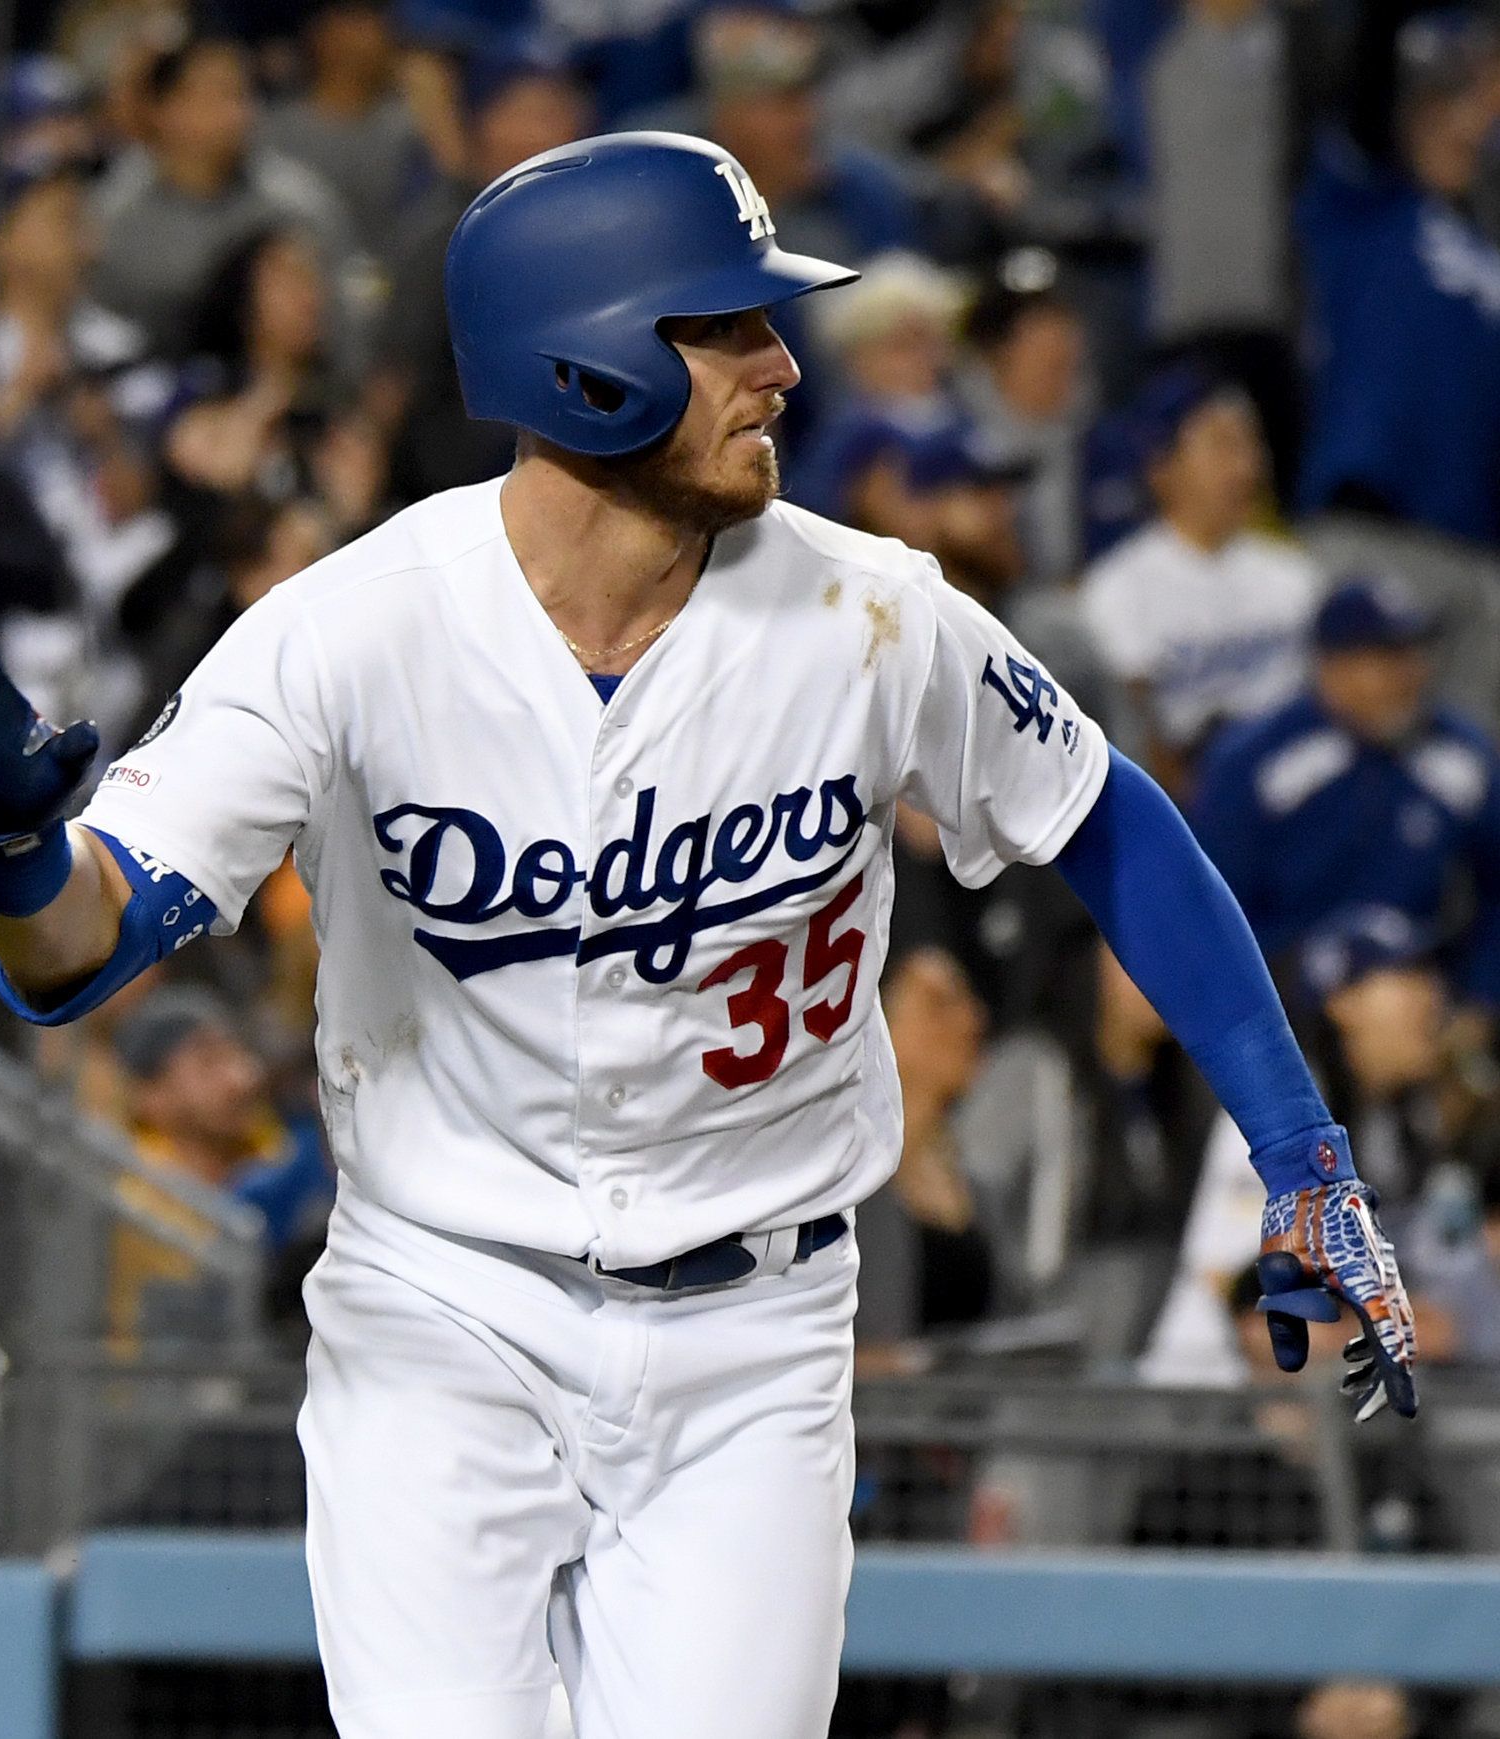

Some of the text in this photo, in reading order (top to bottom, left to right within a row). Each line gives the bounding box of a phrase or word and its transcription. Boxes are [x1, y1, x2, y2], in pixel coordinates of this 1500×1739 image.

[713, 162, 777, 241] LA
[981, 652, 1058, 744] LA
[373, 774, 867, 984] Dodgers
[697, 870, 866, 1090] 35
